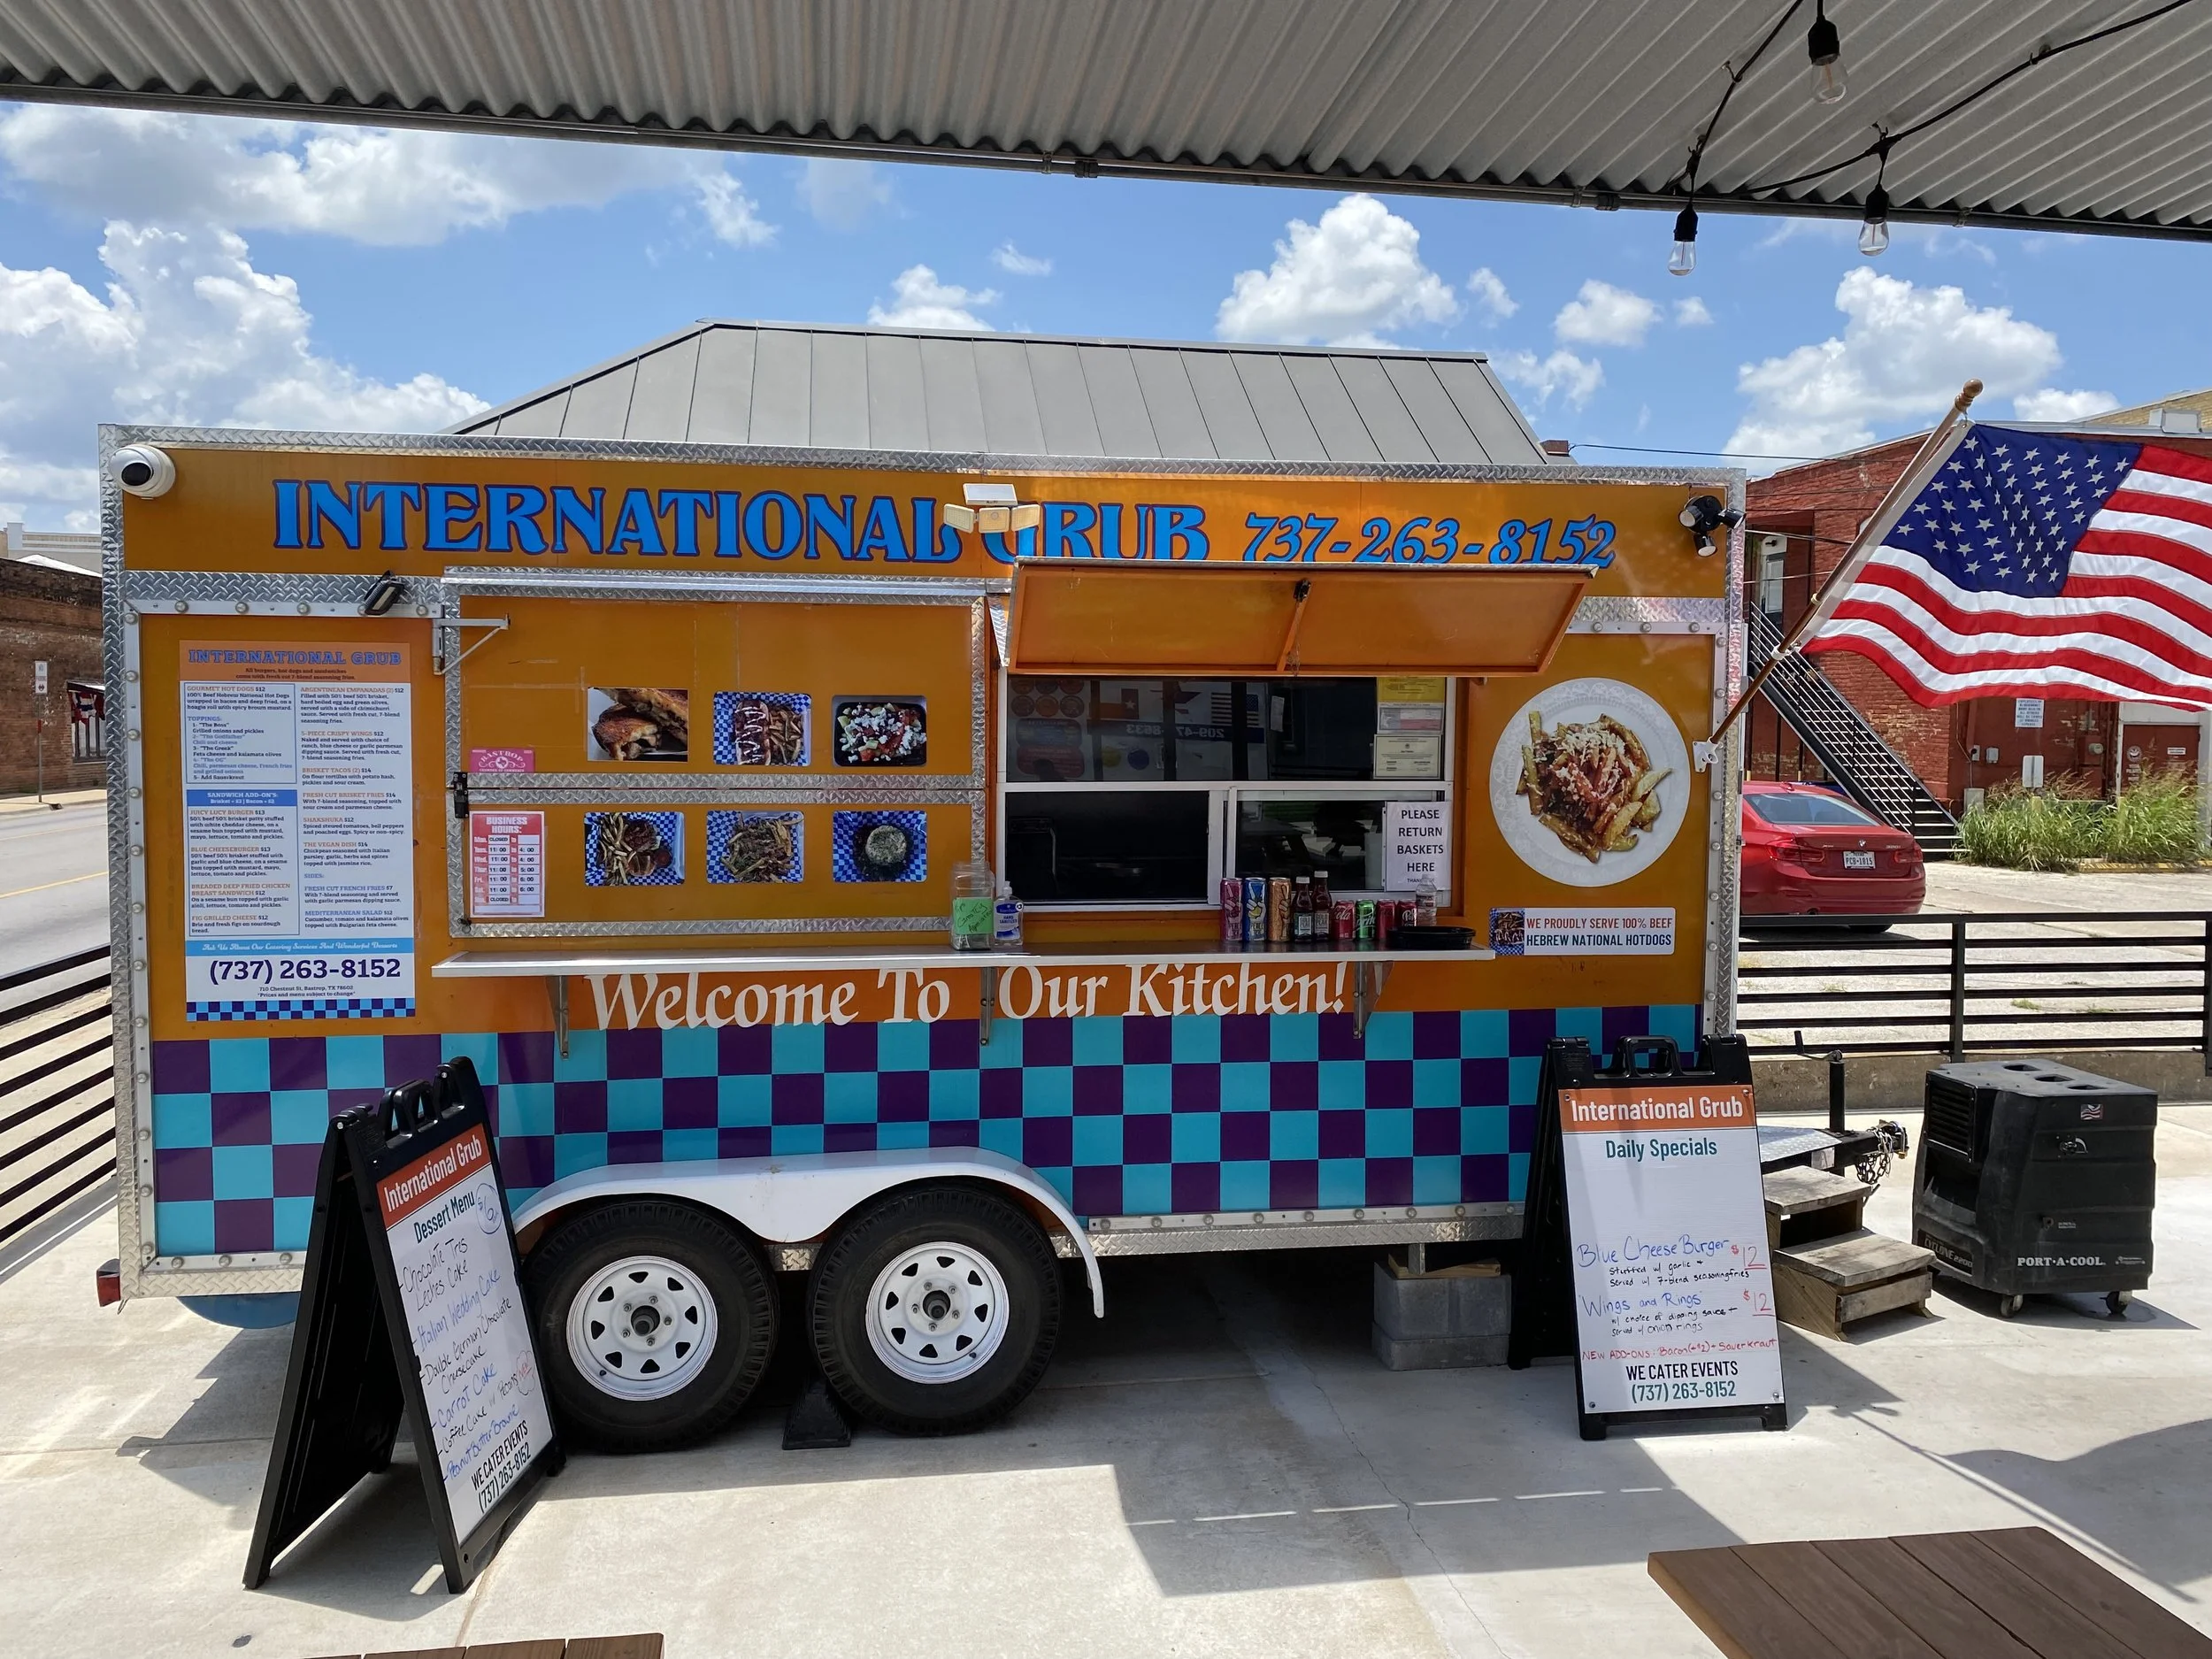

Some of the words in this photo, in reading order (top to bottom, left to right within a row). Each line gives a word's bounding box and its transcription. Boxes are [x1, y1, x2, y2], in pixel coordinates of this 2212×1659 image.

[272, 479, 963, 564] INTERNATIONAL
[1243, 513, 1617, 568] 737-263-8152
[188, 649, 346, 664] INTERNATIONAL
[351, 651, 402, 665] GRUB
[1402, 810, 1440, 818] PLEASE
[1399, 827, 1442, 836] RETURN
[1397, 845, 1443, 854] BASKETS
[1407, 863, 1435, 872] HERE
[1527, 918, 1540, 928] WE
[1545, 918, 1586, 929] PROUDLY
[1590, 918, 1619, 928] SERVE
[1623, 918, 1647, 928] 100%
[1650, 918, 1672, 928] BEEF
[1527, 935, 1569, 946] HEBREW
[1572, 934, 1623, 946] NATIONAL
[1625, 934, 1671, 945] HOTDOGS
[211, 960, 273, 985] (737)
[280, 958, 401, 979] 263-8152
[584, 972, 858, 1031] Welcome
[878, 968, 950, 1024] To
[999, 964, 1109, 1019] Our
[1122, 961, 1348, 1017] Kitchen!
[1571, 1097, 1694, 1121] International
[1700, 1096, 1743, 1118] Grub
[1606, 1140, 1644, 1162] Daily
[1650, 1138, 1717, 1161] Specials
[384, 1148, 457, 1212] International
[457, 1134, 482, 1167] Grub
[414, 1208, 451, 1244] Dessert
[450, 1190, 475, 1219] Menu
[1577, 1244, 1618, 1267] Blue
[1624, 1236, 1677, 1261] Cheese
[1679, 1234, 1730, 1256] Burger
[403, 1243, 444, 1293] Chocolate
[448, 1260, 468, 1287] Cake
[1669, 1262, 1691, 1276] garlic
[418, 1316, 449, 1352] Italian
[448, 1291, 482, 1326] Wedding
[479, 1270, 501, 1296] Cake
[1640, 1298, 1657, 1307] and
[481, 1298, 511, 1334] Chocolate
[1647, 1323, 1672, 1334] onion
[1677, 1322, 1702, 1333] rings
[1582, 1351, 1605, 1361] NEW
[1626, 1365, 1646, 1380] WE
[1648, 1363, 1688, 1379] CATER
[1692, 1361, 1738, 1377] EVENTS
[437, 1385, 471, 1427] Carrot
[472, 1363, 497, 1395] Cake
[1632, 1383, 1669, 1403] (737)
[1672, 1380, 1737, 1400] 263-8152
[466, 1406, 487, 1432] Cake
[471, 1469, 485, 1491] WE
[483, 1445, 505, 1479] CATER
[503, 1420, 528, 1455] EVENTS
[479, 1476, 500, 1513] (737)
[499, 1442, 531, 1489] 263-8152
